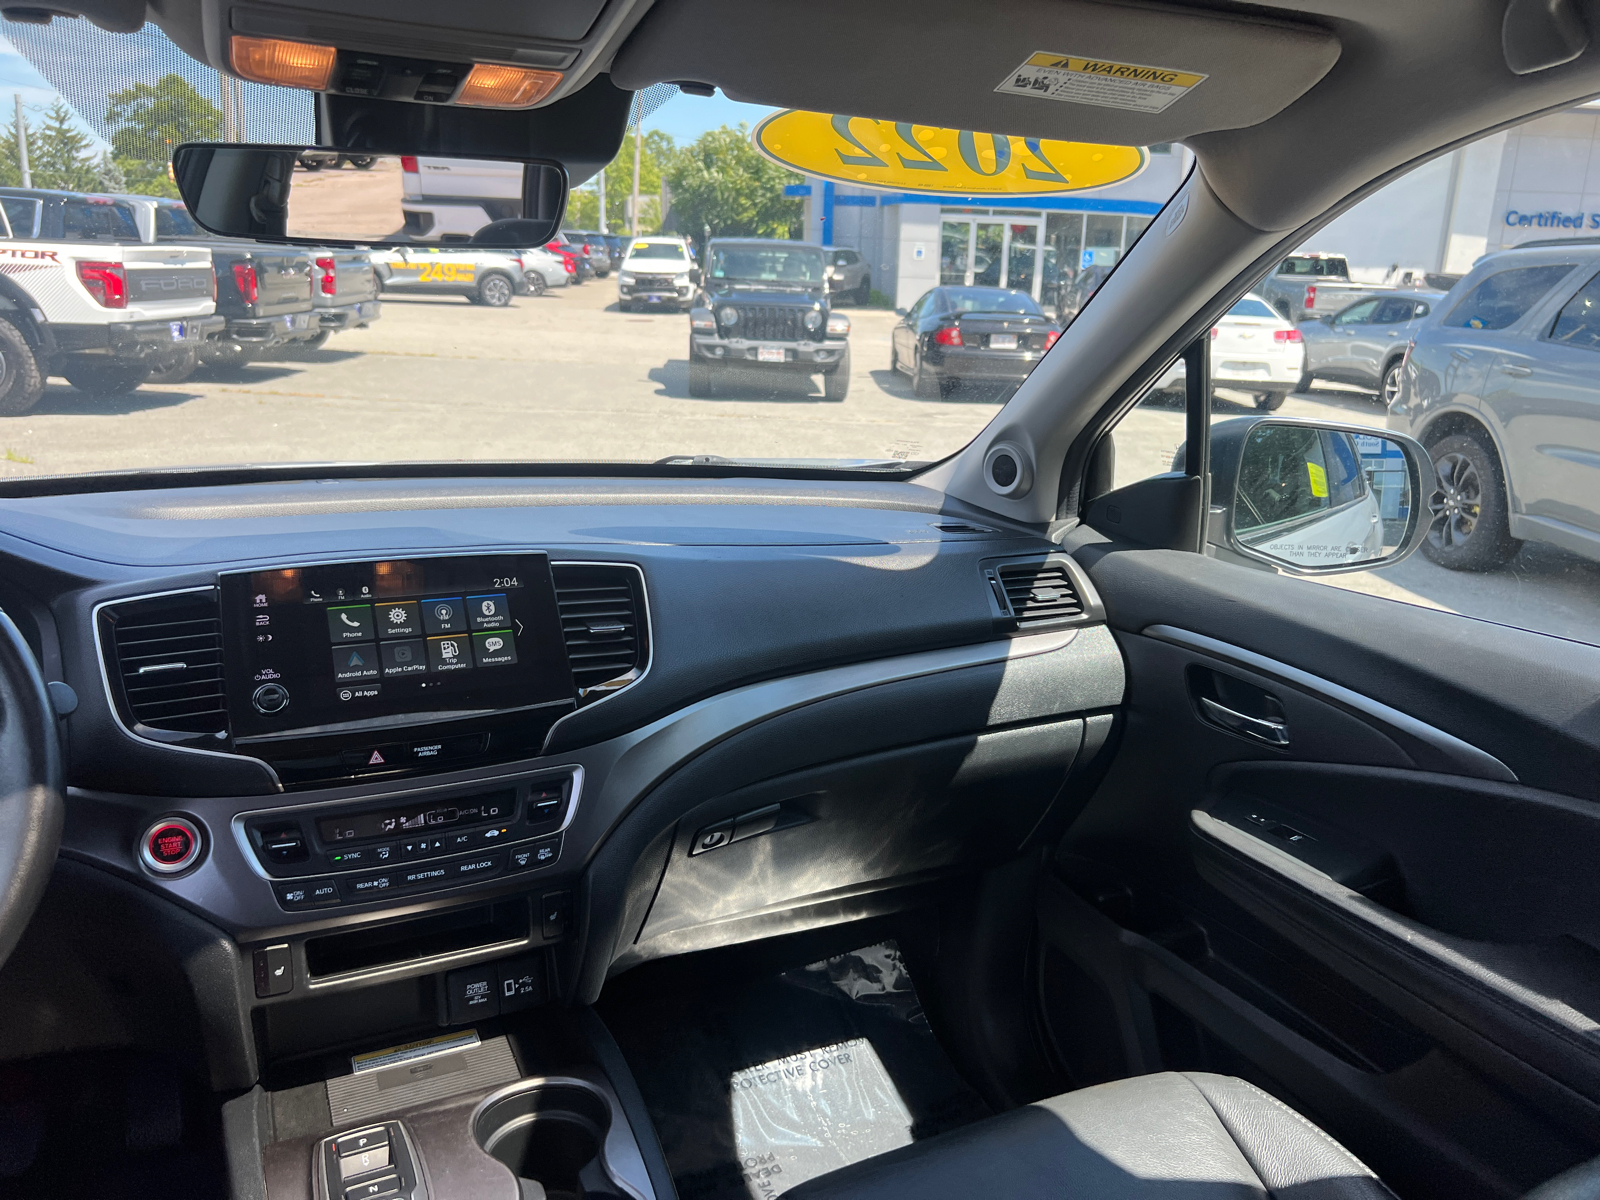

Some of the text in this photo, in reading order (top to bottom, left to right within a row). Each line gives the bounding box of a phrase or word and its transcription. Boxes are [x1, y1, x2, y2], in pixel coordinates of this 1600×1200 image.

[1082, 61, 1178, 84] WARNING
[1036, 67, 1062, 76] EVEN
[1062, 70, 1086, 79] WITH
[1086, 73, 1132, 87] ADVANCED
[1132, 80, 1148, 88] AIR
[1148, 82, 1173, 91] BAGS
[1505, 209, 1585, 229] Certified
[418, 262, 458, 283] 249
[140, 276, 207, 291] FORD
[1269, 543, 1295, 551] OBJECTS
[1306, 544, 1328, 552] MIRROR
[493, 576, 519, 588] 2:04
[476, 615, 504, 623] Bluetooth
[343, 631, 363, 639] Phone
[387, 627, 413, 635] Settings
[487, 640, 502, 648] SMS
[482, 655, 512, 664] Messages
[384, 664, 426, 675] Apple CarPlay
[438, 662, 467, 671] Computer
[337, 670, 362, 679] Android
[364, 689, 379, 697] Apps
[158, 835, 183, 843] ENGINE
[456, 835, 468, 843] A/C
[162, 849, 181, 857] STOP
[343, 852, 362, 860] SYNC
[460, 860, 493, 872] REAR LOCK
[407, 869, 445, 882] RR SETTINGS
[356, 881, 373, 889] REAR
[315, 886, 333, 895] AUTO
[466, 981, 488, 990] POWER
[466, 986, 489, 995] OUTLET
[776, 1049, 813, 1066] MUST
[808, 1052, 853, 1072] COVER
[359, 1138, 367, 1147] P
[369, 1184, 378, 1193] N
